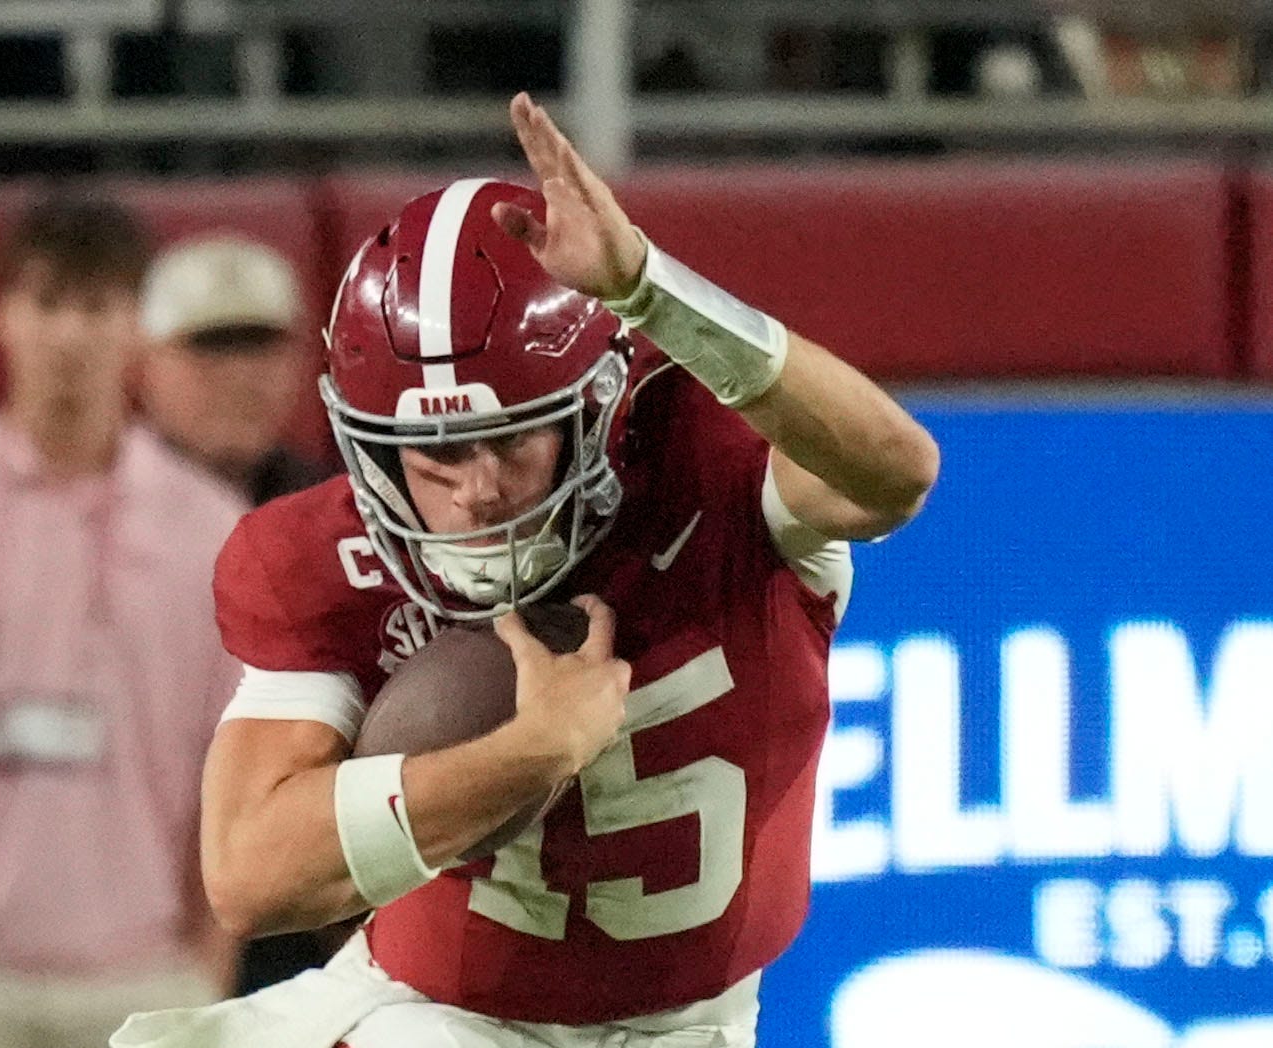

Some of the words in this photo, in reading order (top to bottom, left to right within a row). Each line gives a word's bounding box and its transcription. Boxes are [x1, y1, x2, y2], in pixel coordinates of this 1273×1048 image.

[419, 394, 472, 415] BAMA
[337, 536, 384, 589] C
[1032, 877, 1273, 968] EST.
